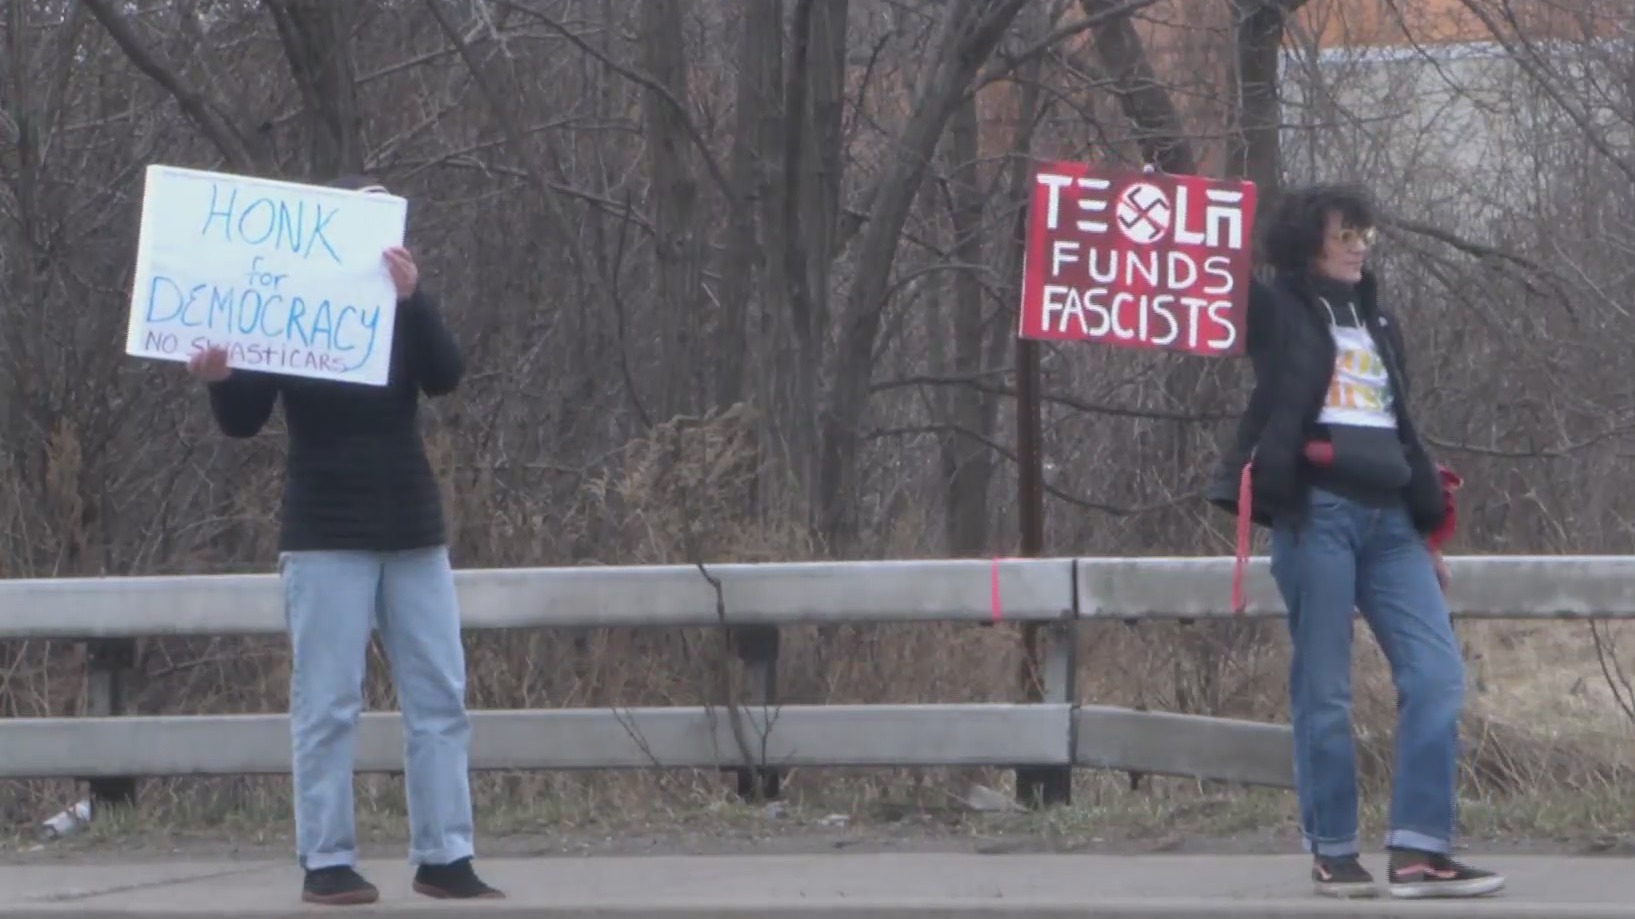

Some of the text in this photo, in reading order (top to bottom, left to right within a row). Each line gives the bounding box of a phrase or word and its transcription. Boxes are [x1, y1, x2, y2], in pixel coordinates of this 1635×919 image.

[202, 184, 341, 263] HONK
[1036, 173, 1243, 249] TELA
[248, 256, 288, 288] for
[1052, 241, 1234, 294] FUNDS
[144, 331, 178, 353] NO
[146, 276, 380, 372] DEMOCRACY
[1041, 285, 1237, 349] FASCISTS
